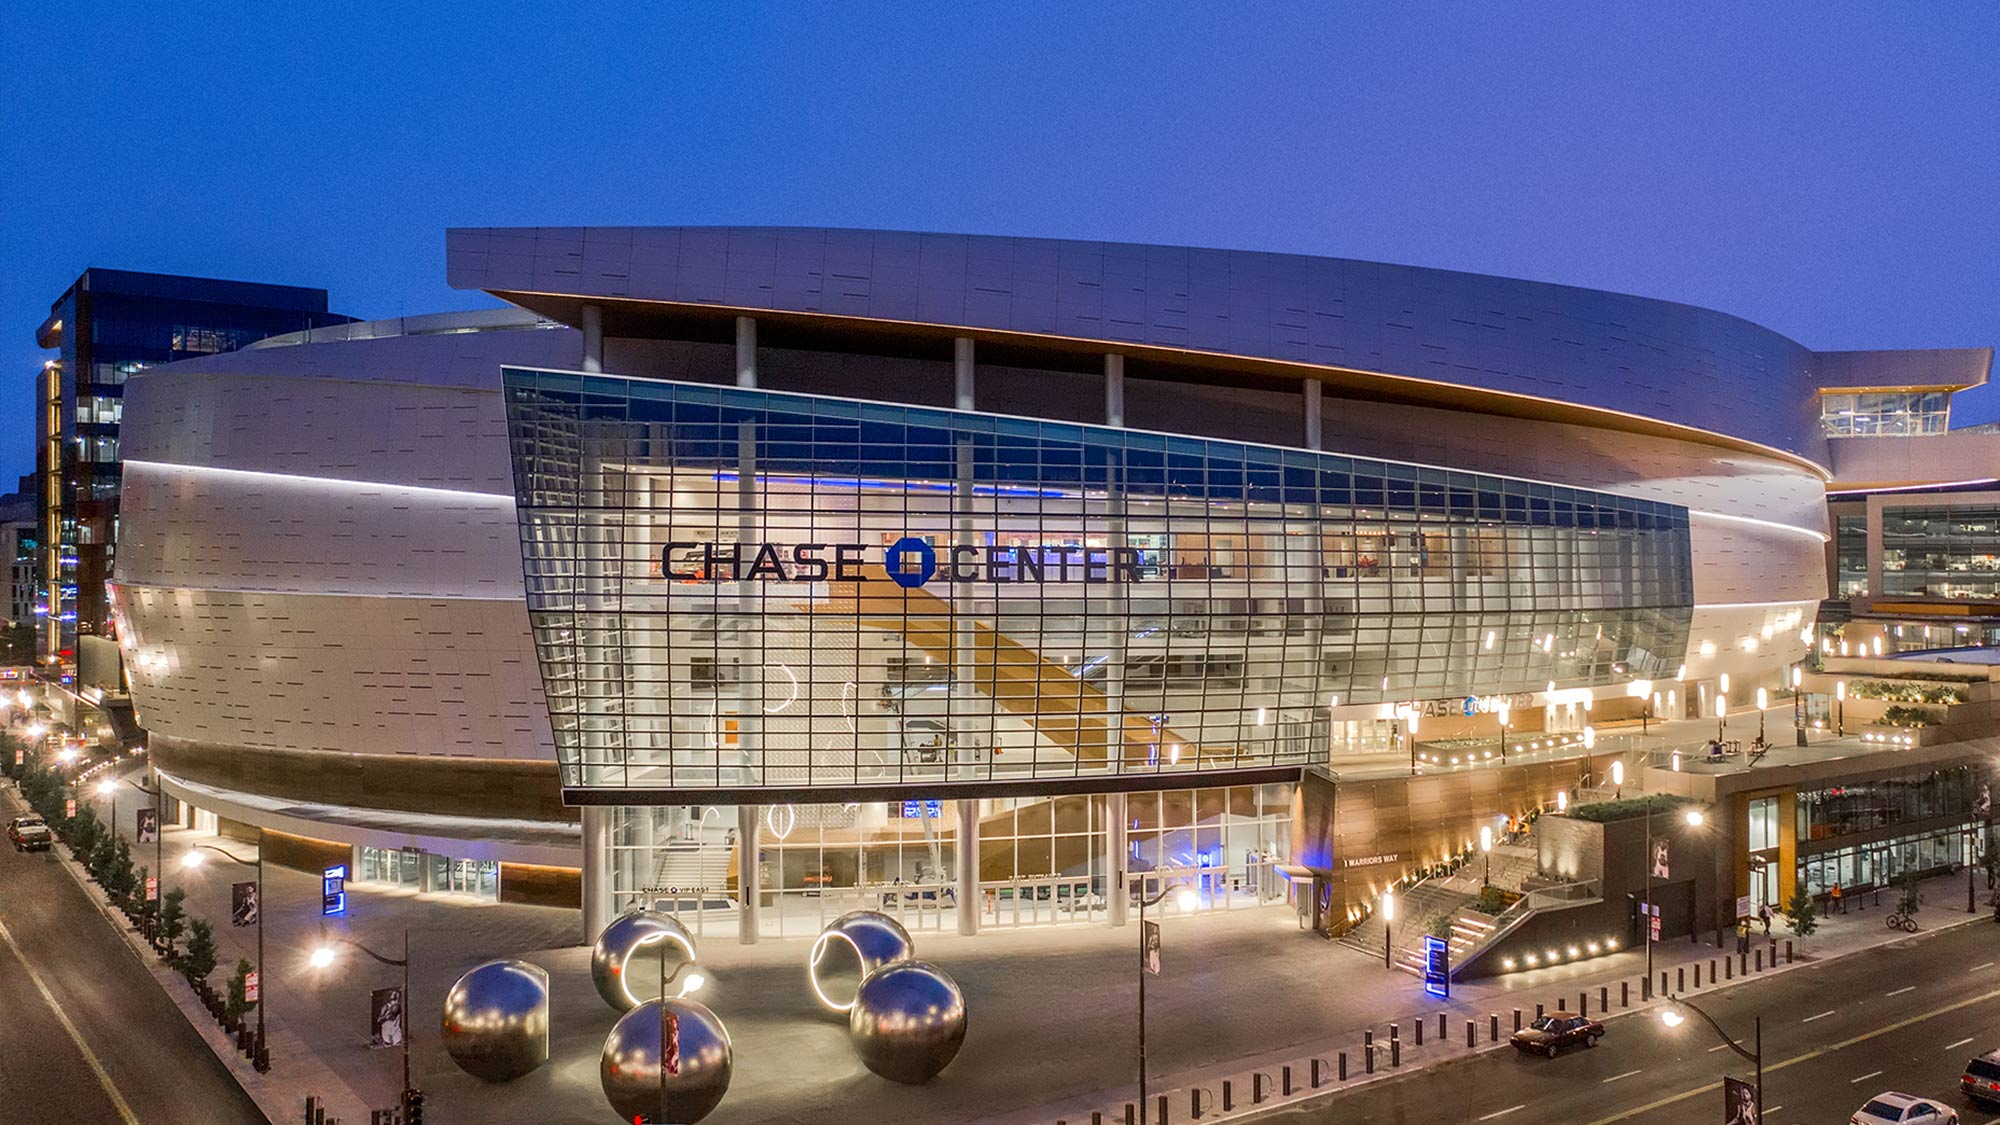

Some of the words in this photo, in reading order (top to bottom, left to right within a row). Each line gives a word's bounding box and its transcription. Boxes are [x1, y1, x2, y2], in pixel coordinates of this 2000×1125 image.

[662, 541, 869, 582] CHASE
[951, 544, 1142, 584] CENTER
[1349, 856, 1383, 867] WARRIORS
[1383, 854, 1398, 863] WAY
